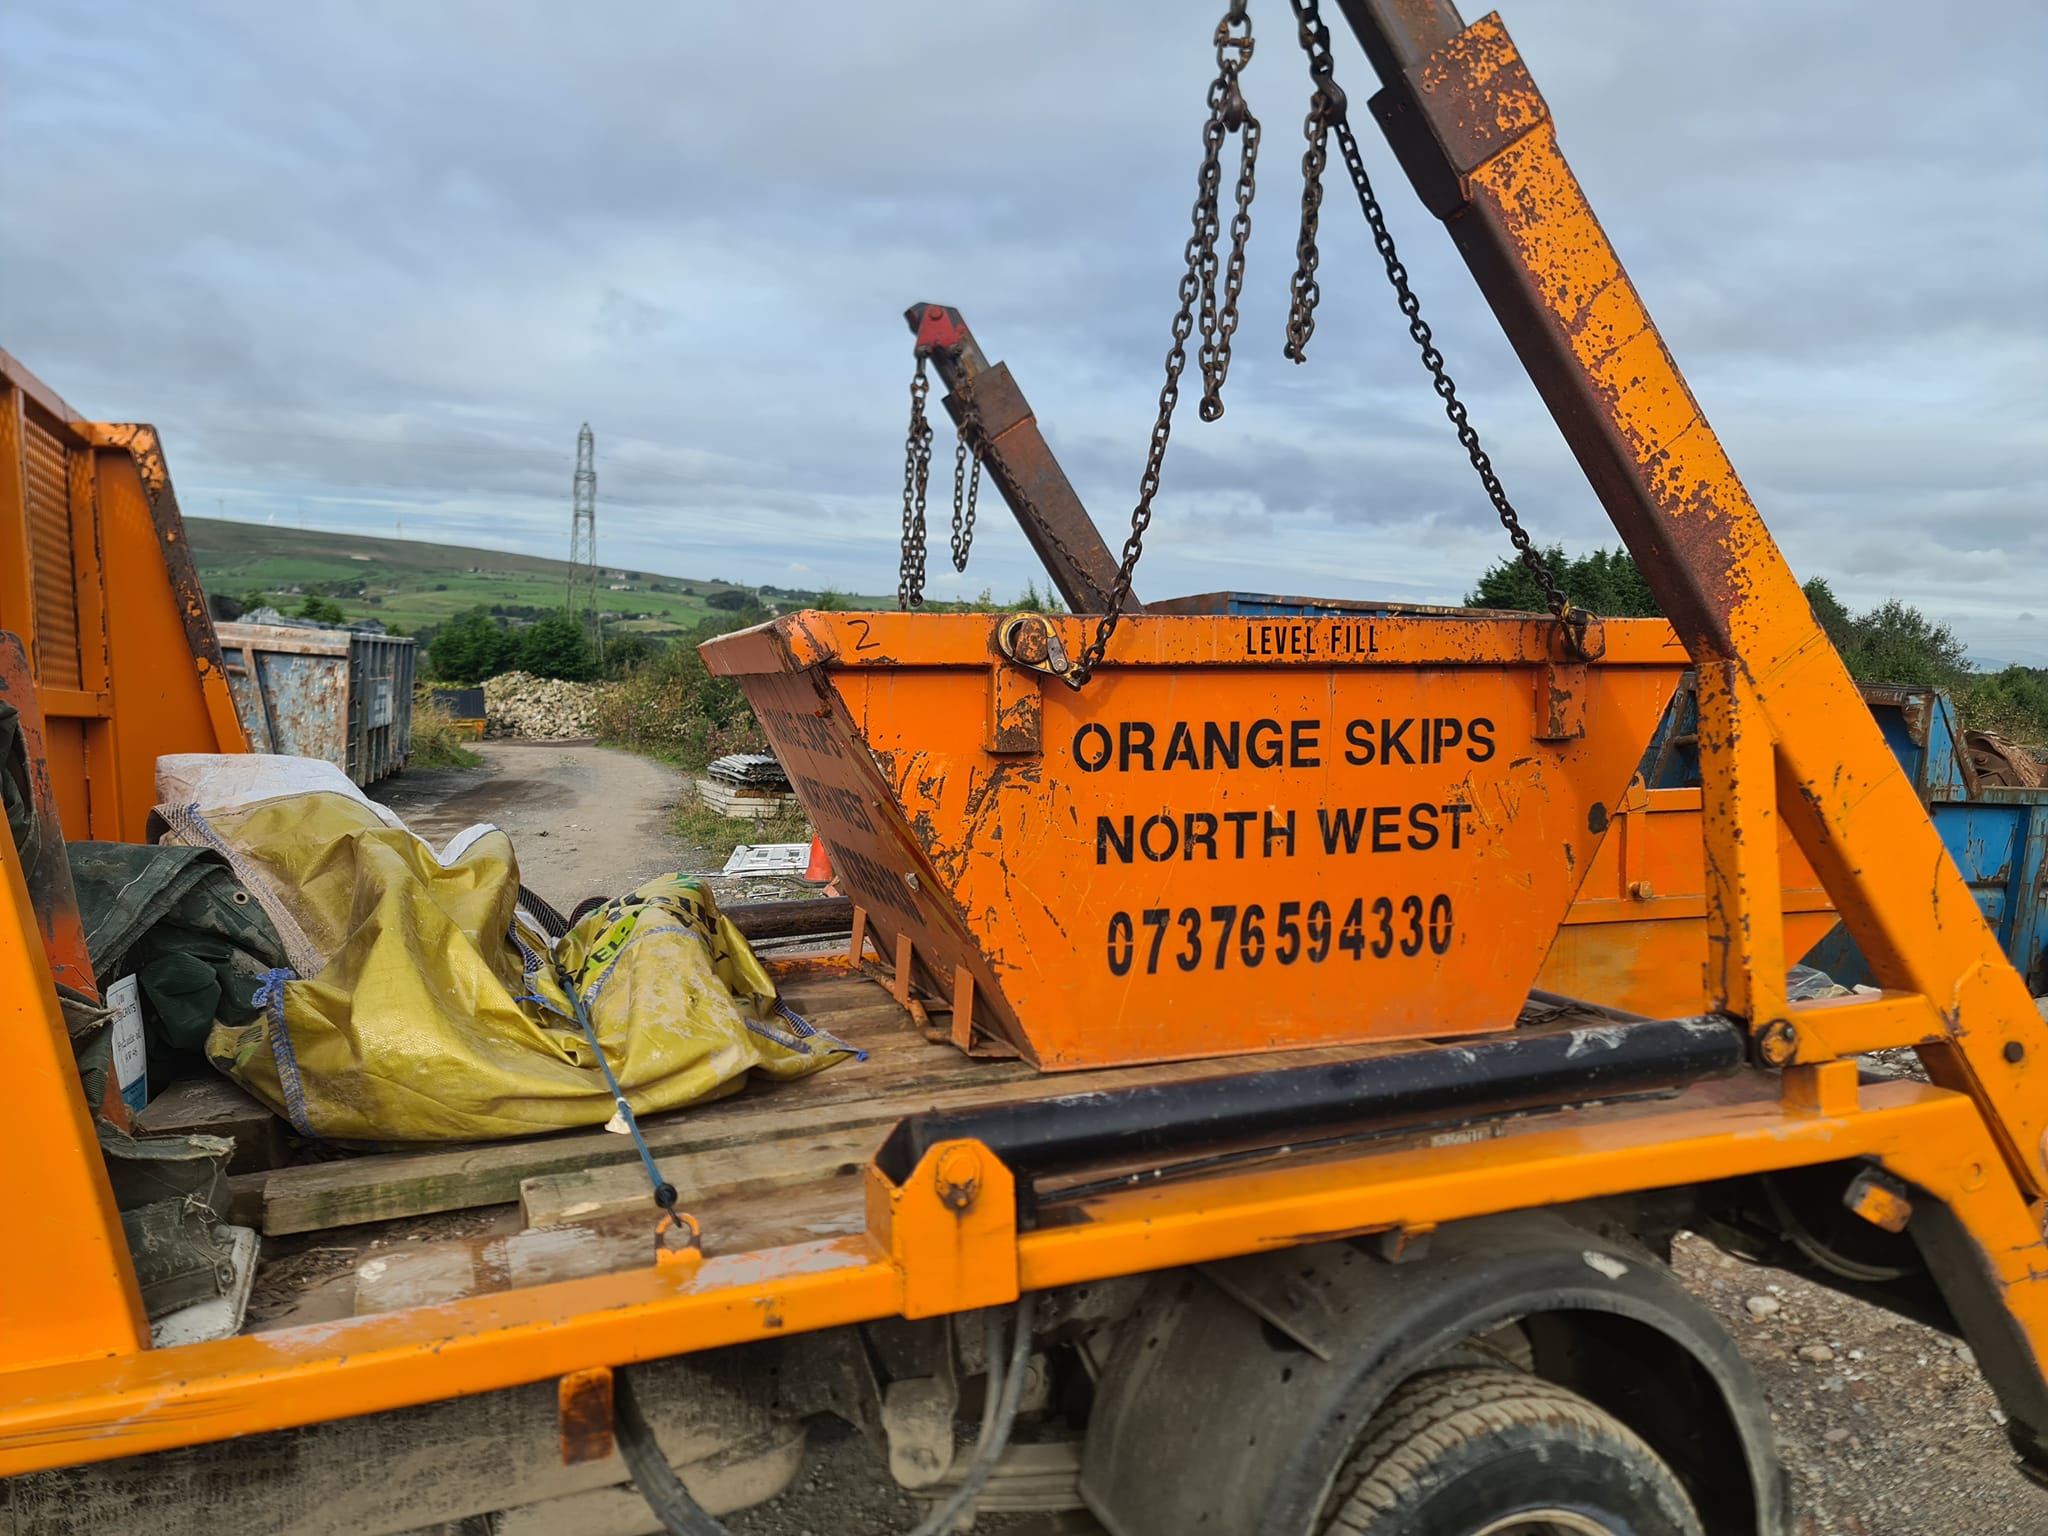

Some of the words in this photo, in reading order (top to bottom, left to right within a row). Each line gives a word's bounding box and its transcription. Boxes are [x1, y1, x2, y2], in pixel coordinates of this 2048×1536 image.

[847, 620, 880, 651] 2
[1246, 625, 1316, 655] LEVEL
[1331, 625, 1379, 654] FILL
[1073, 718, 1321, 773] ORANGE
[1344, 717, 1496, 766] SKIPS
[1096, 810, 1296, 865] NORTH
[1316, 802, 1473, 855] WEST
[1107, 893, 1453, 977] 07376594330
